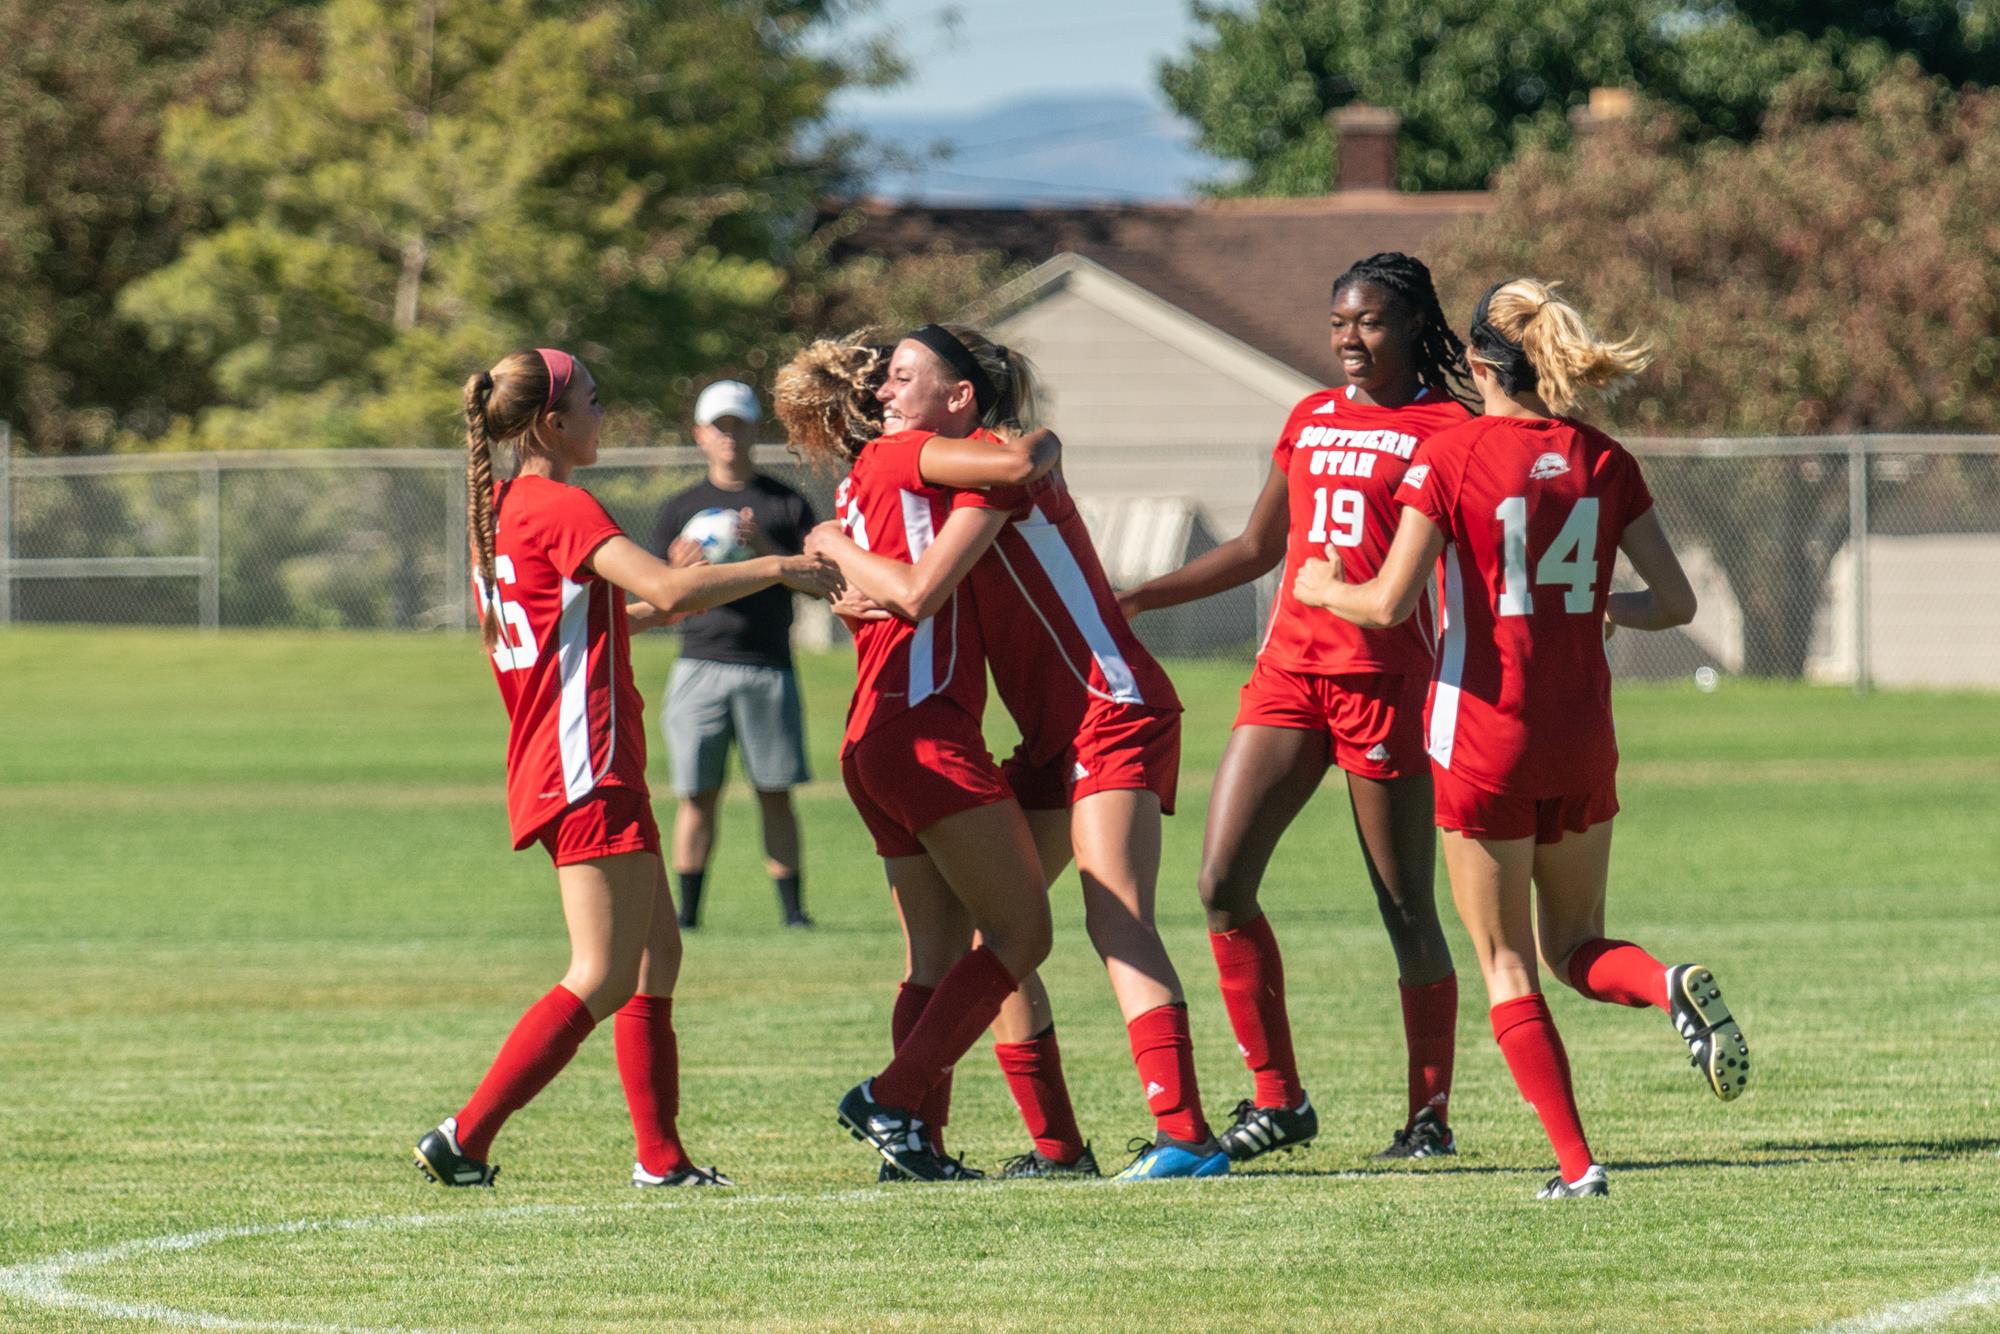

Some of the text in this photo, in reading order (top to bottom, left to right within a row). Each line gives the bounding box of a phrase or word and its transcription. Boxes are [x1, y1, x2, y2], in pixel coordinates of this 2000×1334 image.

[1296, 426, 1417, 459] SOUTHERN
[1309, 450, 1377, 478] UTAH
[1308, 487, 1365, 547] 19
[1496, 497, 1599, 616] 14
